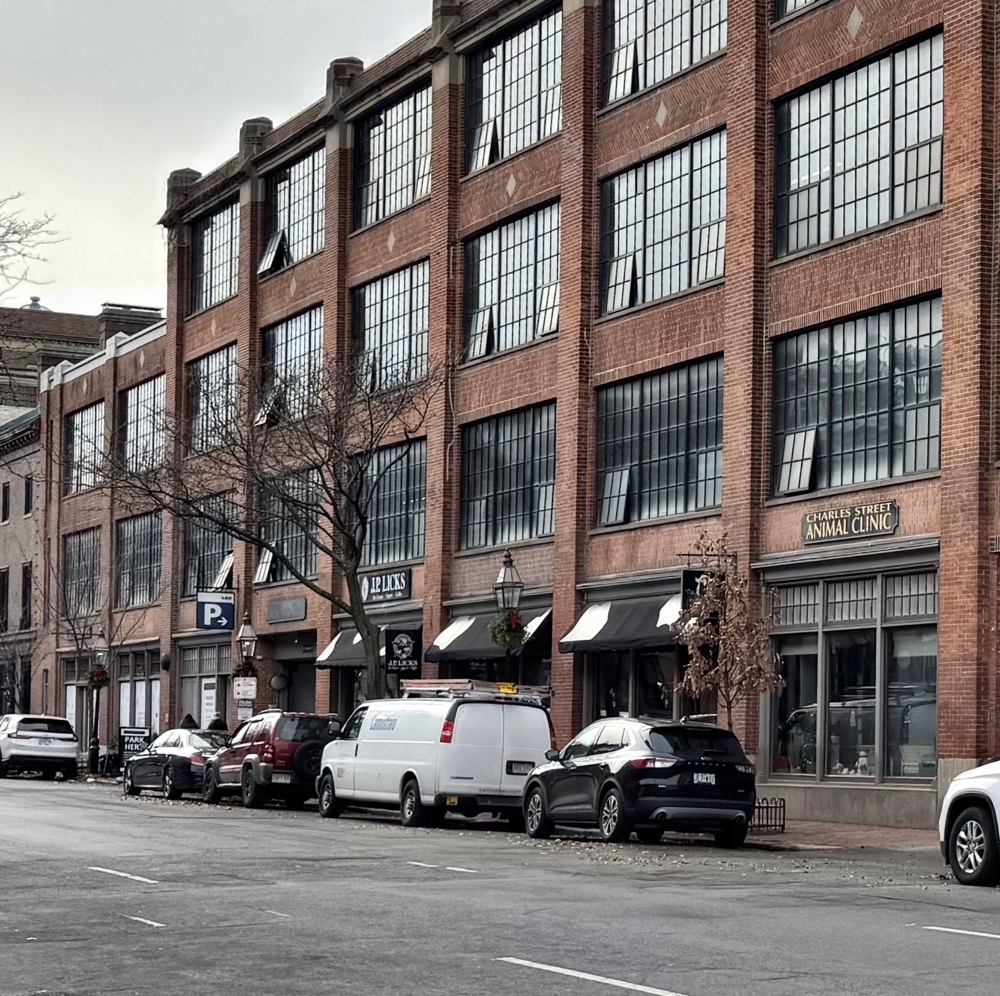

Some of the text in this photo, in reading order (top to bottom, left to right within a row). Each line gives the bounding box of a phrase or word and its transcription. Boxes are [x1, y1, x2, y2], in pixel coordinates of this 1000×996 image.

[806, 503, 892, 522] CHARLES STREET
[806, 512, 892, 540] ANIMAL CLINIC
[382, 572, 406, 592] LICKS
[203, 603, 222, 625] P
